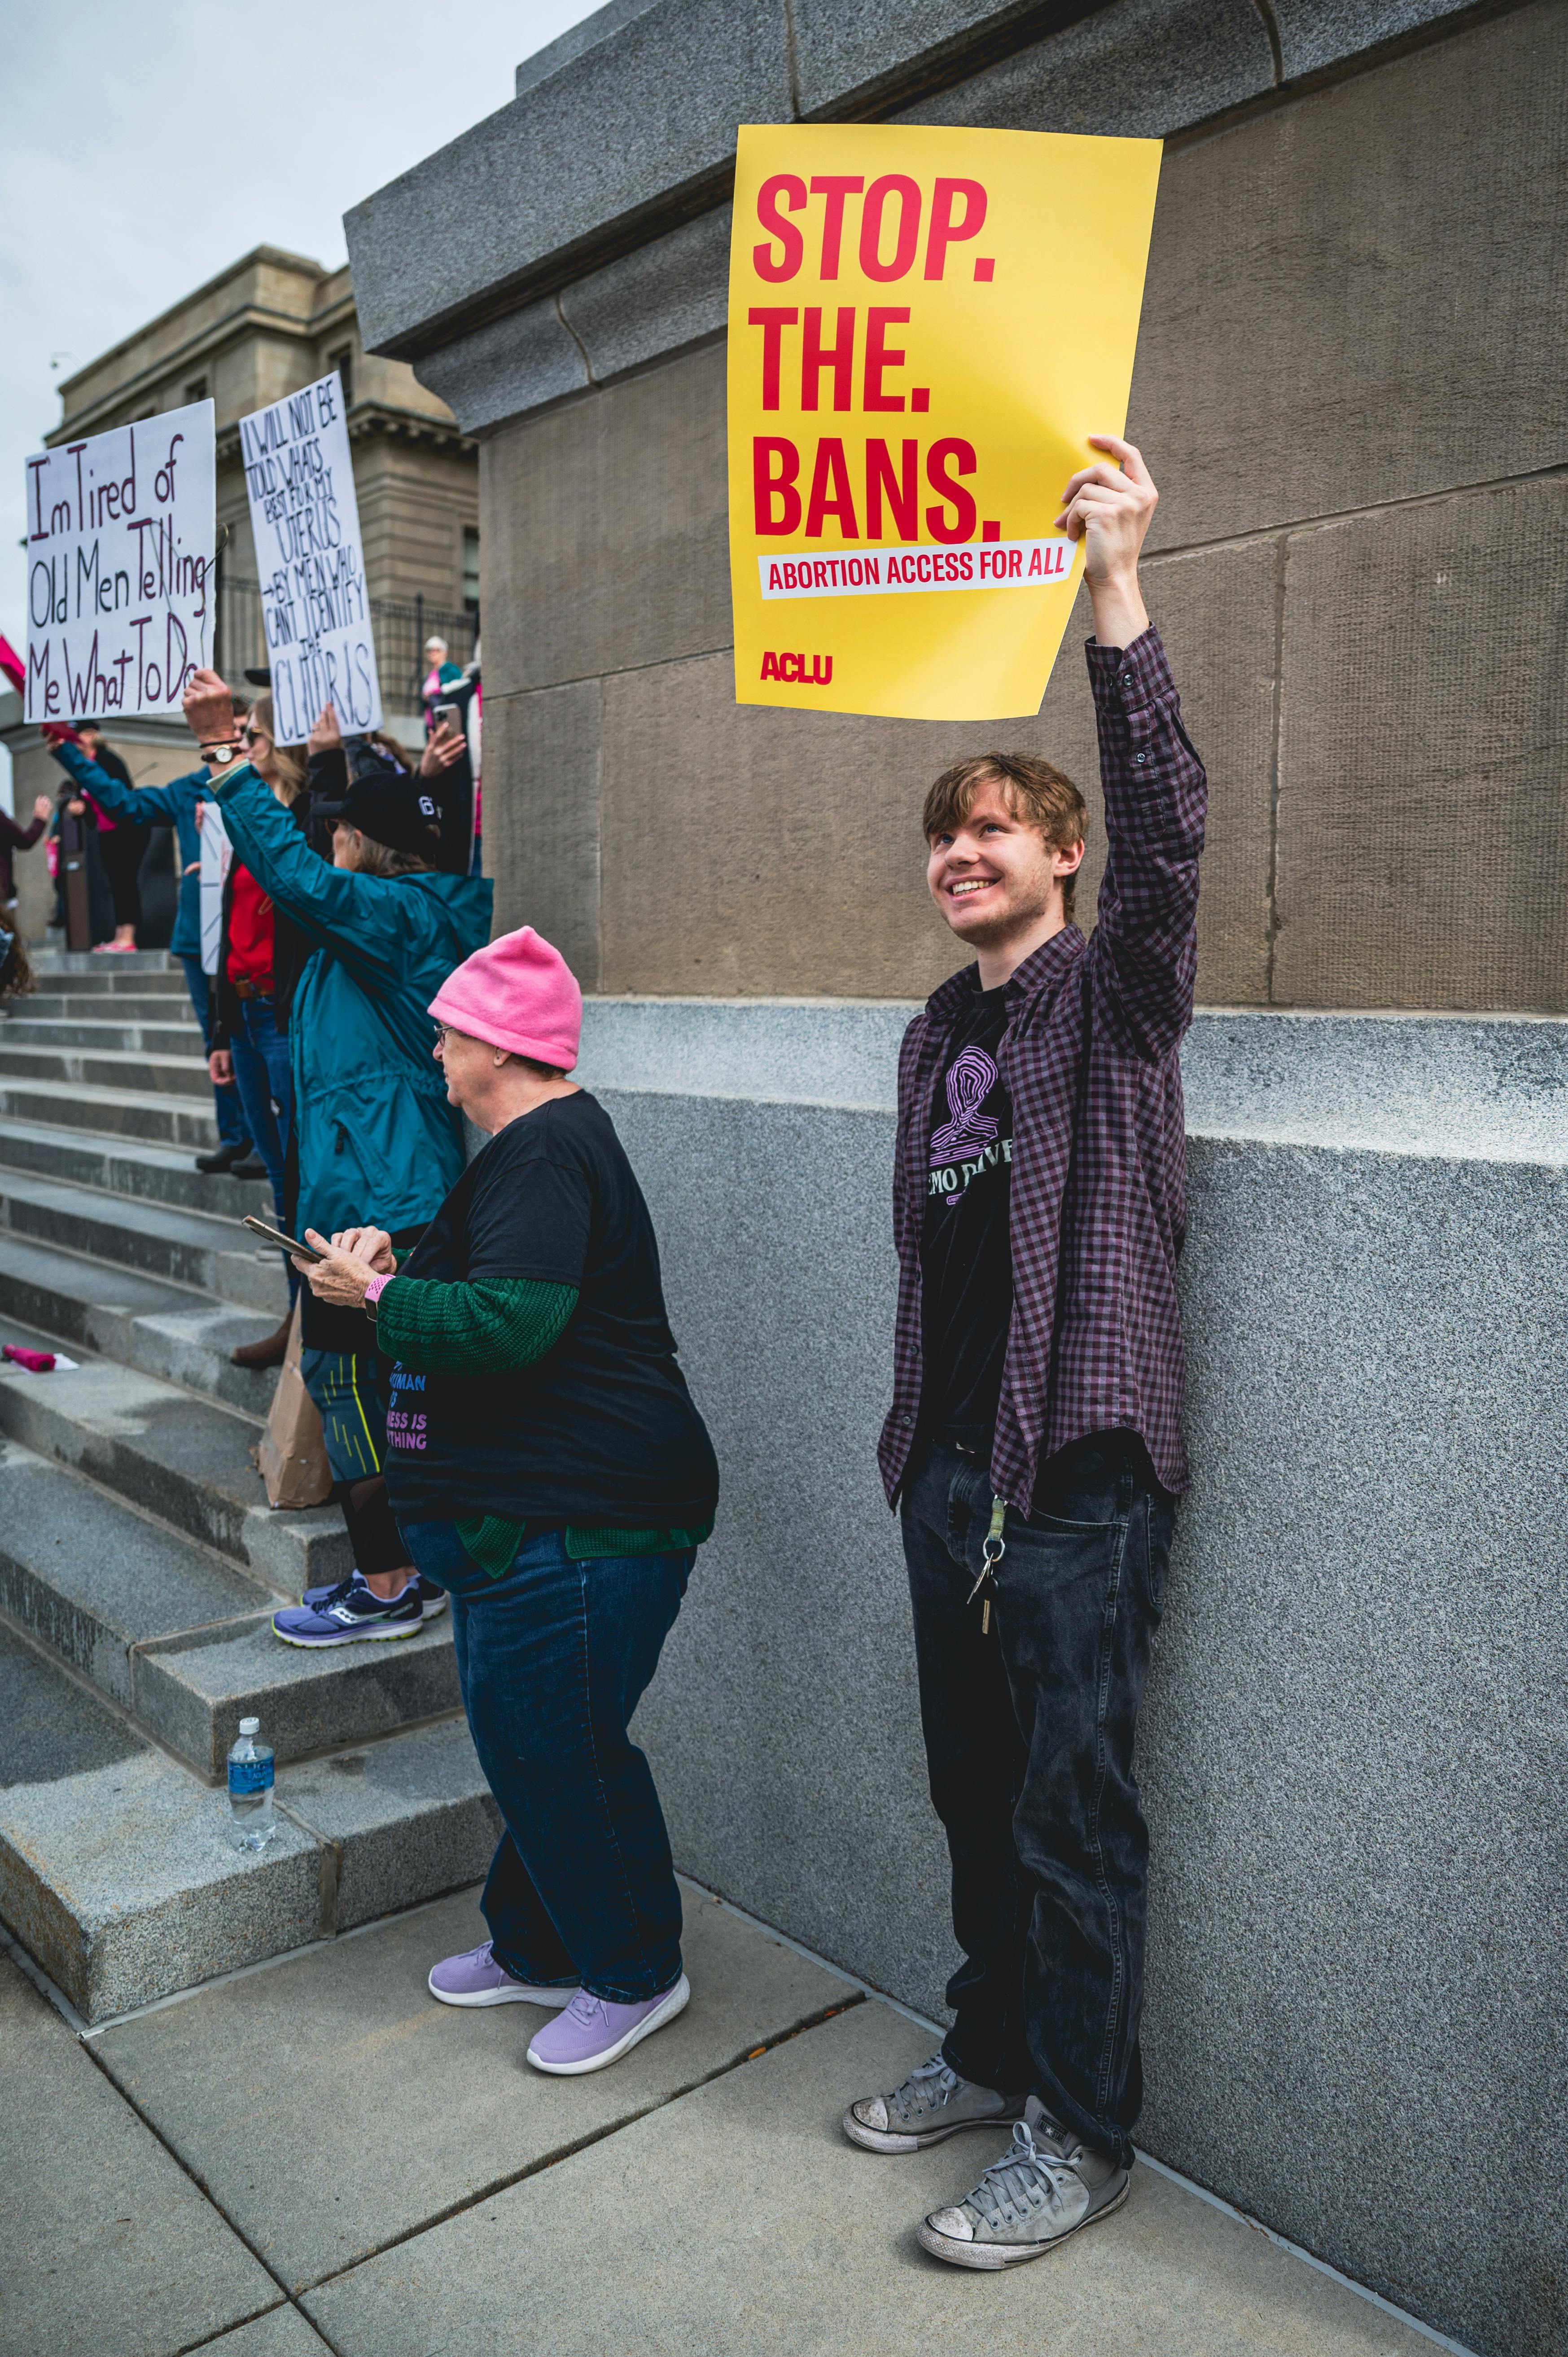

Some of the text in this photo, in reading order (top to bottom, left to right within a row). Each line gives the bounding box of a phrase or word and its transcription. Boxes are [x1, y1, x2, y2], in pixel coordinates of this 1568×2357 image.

[753, 173, 996, 284] STOP.
[748, 307, 931, 413] THE.
[250, 407, 289, 456] WILL
[287, 389, 315, 441] NOT
[316, 379, 337, 428] BE
[66, 425, 136, 531] Tired
[154, 433, 184, 503] of
[245, 457, 278, 503] TOLD
[263, 466, 333, 524] BEST FOR MY
[753, 436, 1002, 545] BANS.
[275, 496, 342, 564] UTERUS
[30, 513, 206, 629] Old Men Telling
[273, 543, 358, 603] BY MEN WHO
[769, 546, 1065, 591] ABORTION ACCESS FOR ALL
[302, 574, 364, 638] IDENTIFY
[28, 638, 61, 719] Me
[62, 628, 134, 715] What
[129, 615, 162, 711] To
[298, 637, 322, 654] THE
[760, 651, 833, 685] ACLU
[275, 640, 372, 742] CLITORIS
[928, 1167, 958, 1195] MO
[411, 1413, 427, 1430] IS
[1051, 2130, 1065, 2145] STAR
